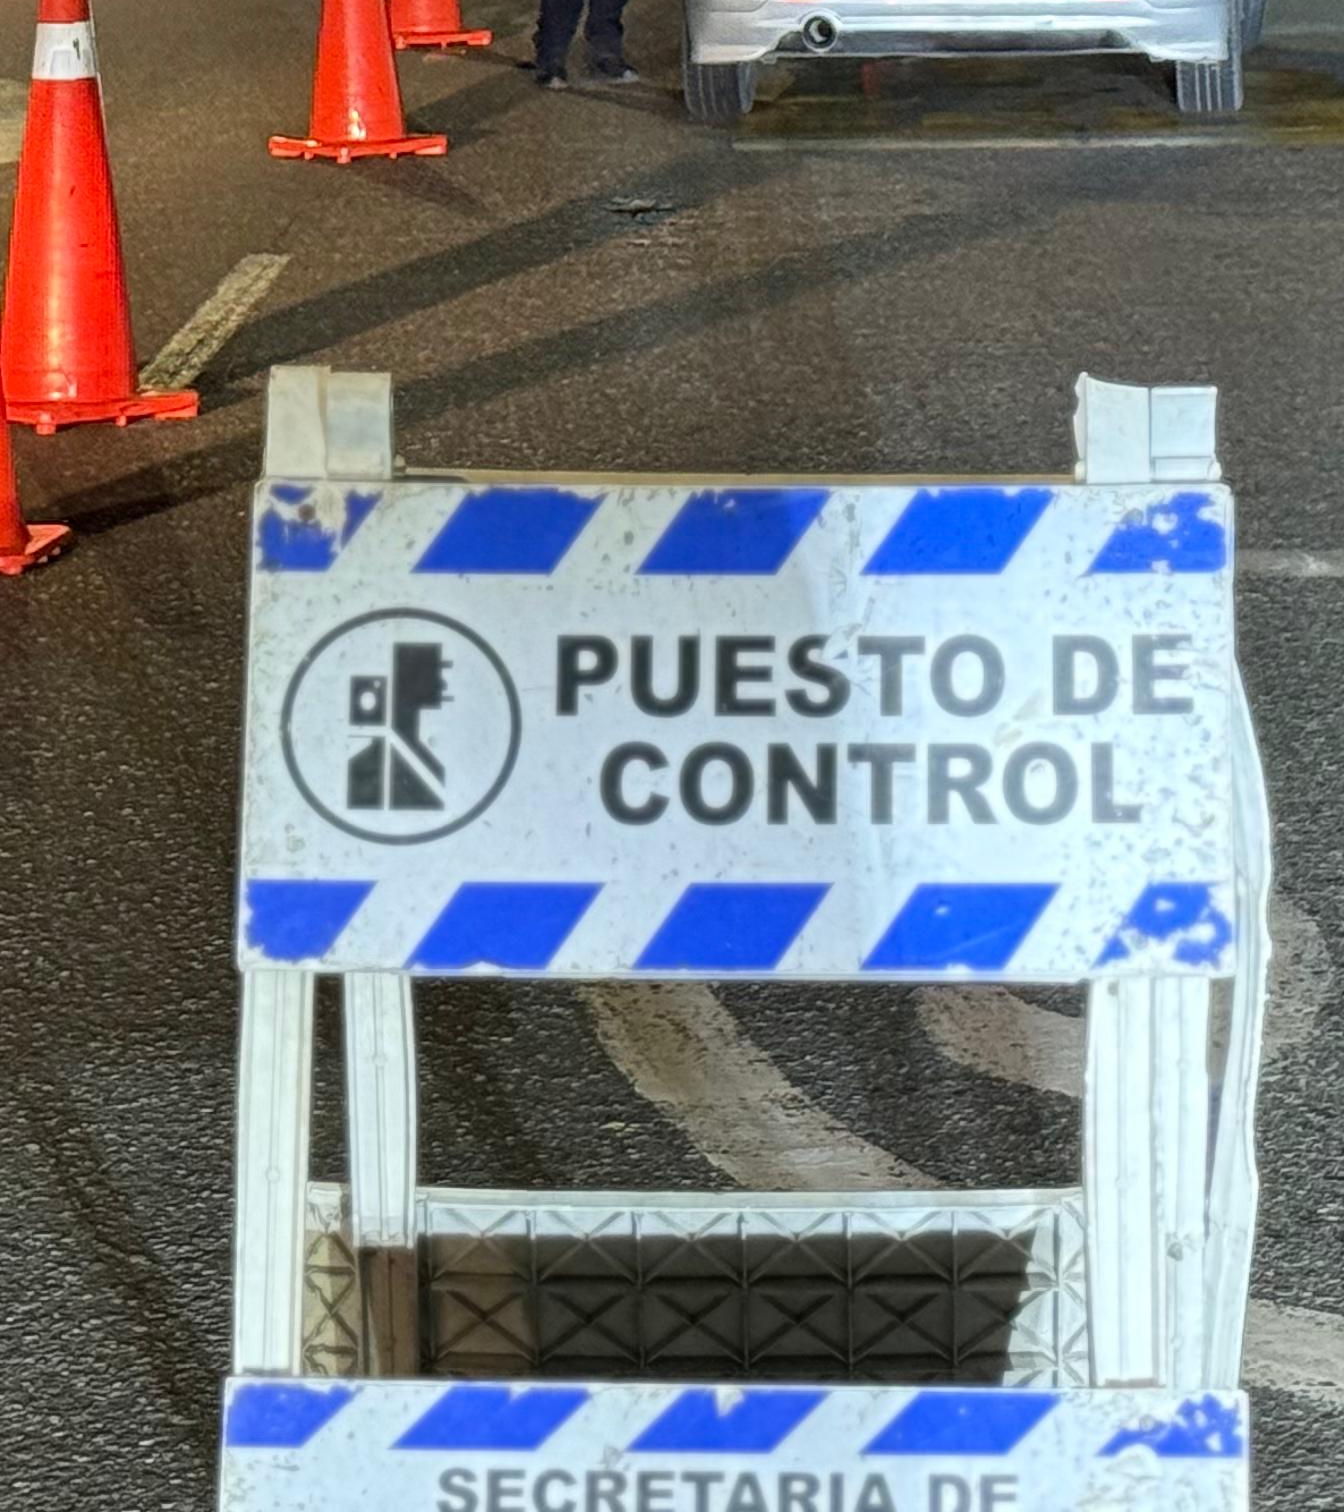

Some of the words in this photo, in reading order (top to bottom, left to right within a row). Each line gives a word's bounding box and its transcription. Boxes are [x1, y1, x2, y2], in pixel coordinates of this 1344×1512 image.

[555, 634, 1006, 718] PUESTO
[1052, 634, 1196, 716] DE
[599, 741, 1144, 826] CONTROL
[438, 1469, 897, 1512] SECRETARIA
[928, 1473, 1020, 1512] DE
